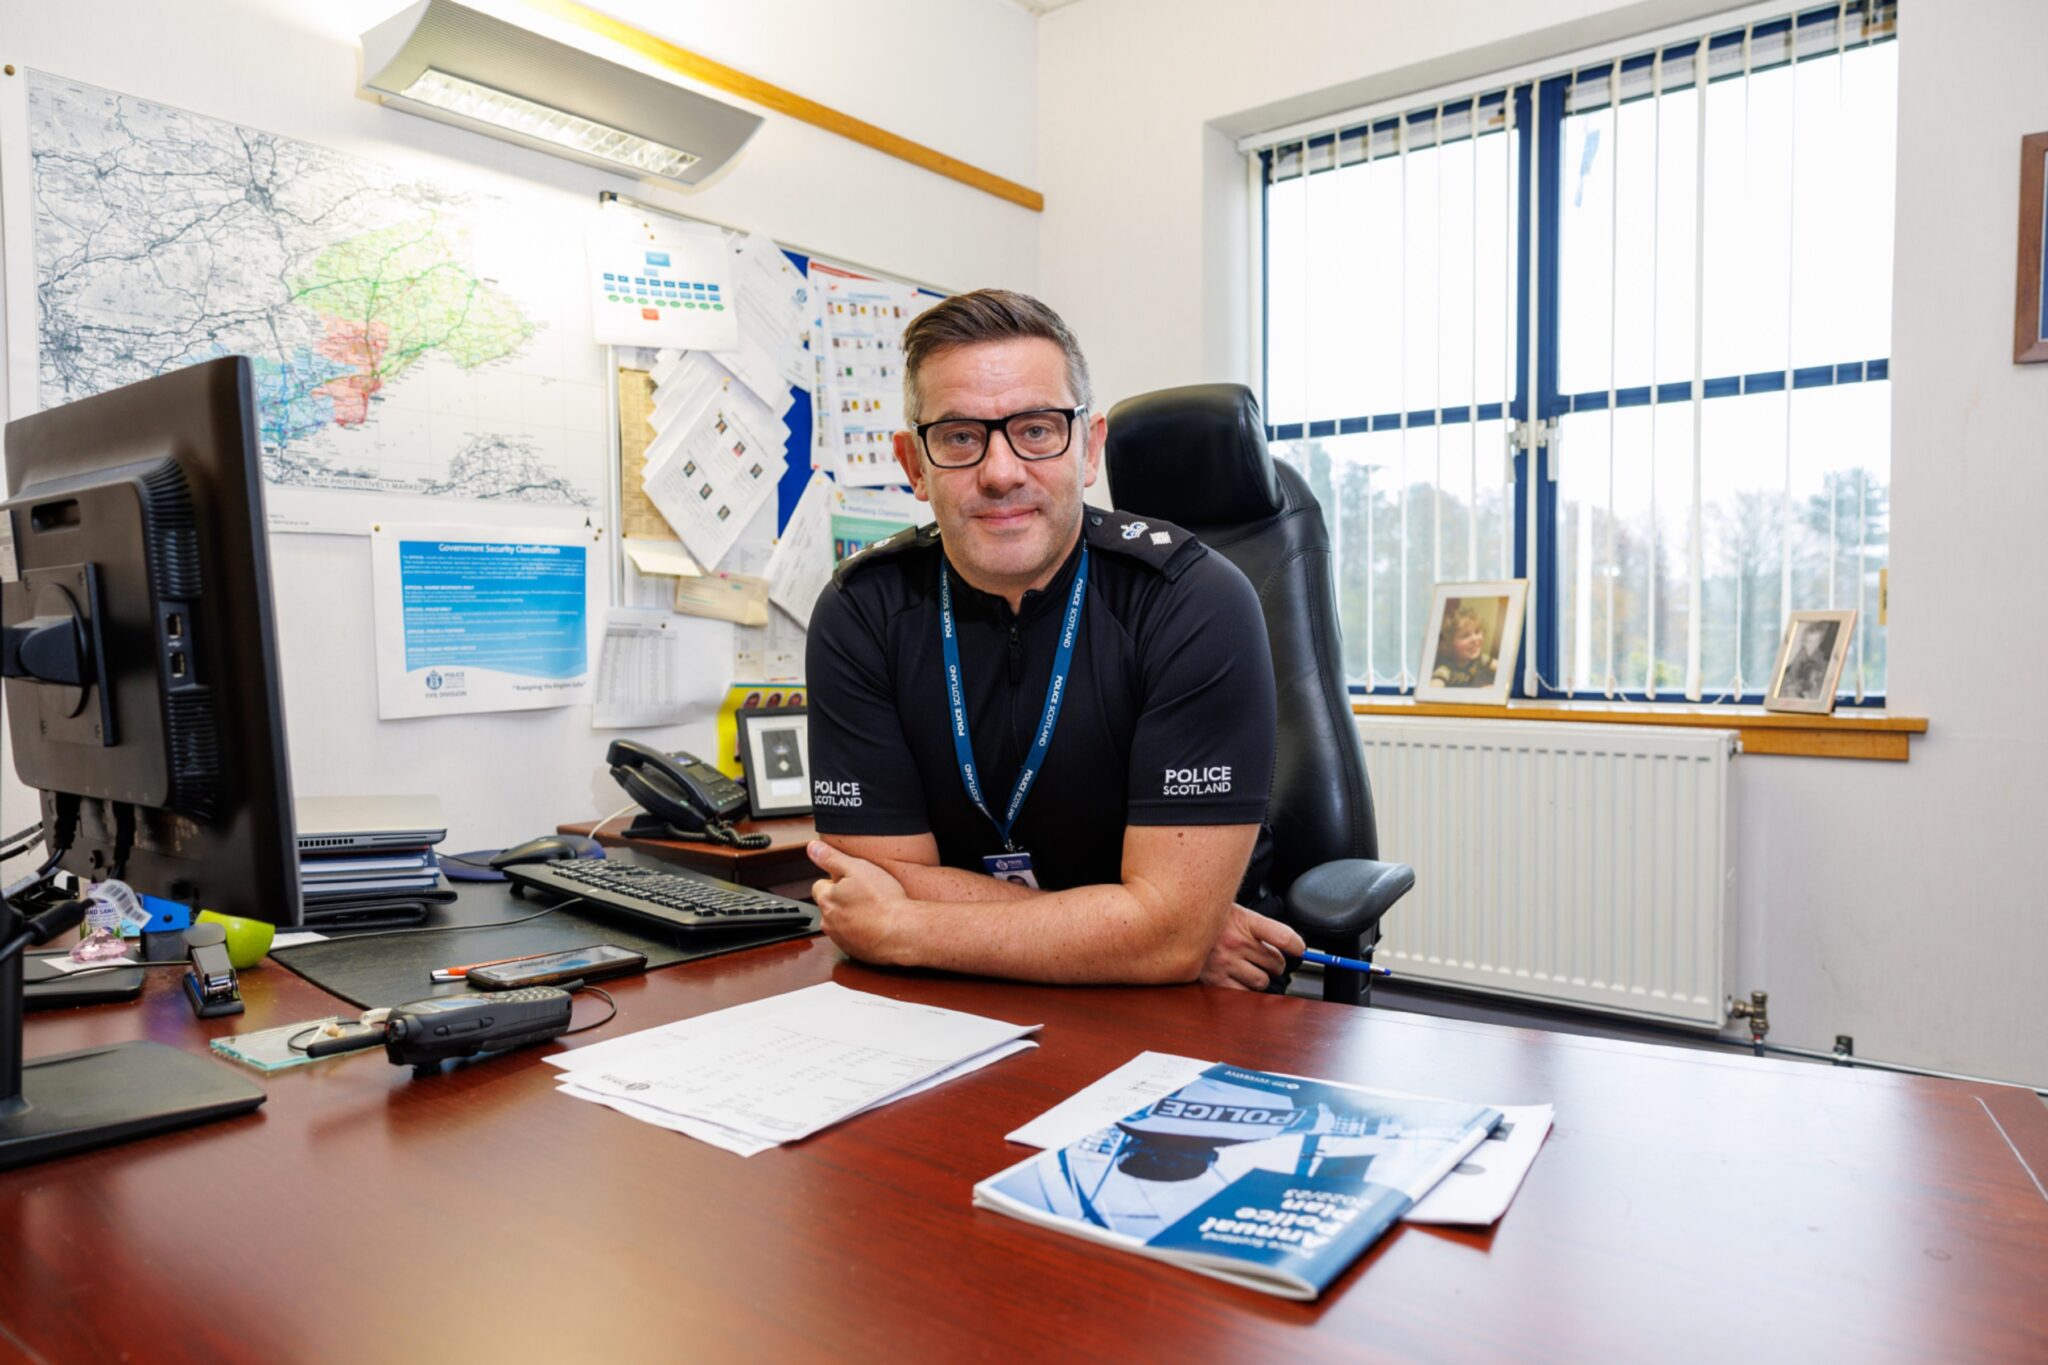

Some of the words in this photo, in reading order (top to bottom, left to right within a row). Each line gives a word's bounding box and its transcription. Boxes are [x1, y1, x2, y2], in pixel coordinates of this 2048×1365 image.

[438, 543, 484, 553] Government
[485, 544, 515, 556] Security
[515, 544, 561, 555] Classification
[1072, 577, 1084, 607] POLICE
[944, 610, 953, 638] POLICE
[1063, 607, 1078, 648] SCOTLAND
[949, 664, 961, 706] SCOTLAND
[1050, 674, 1063, 705] POLICE
[955, 708, 966, 736] POLICE
[1039, 704, 1056, 747] SCOTLAND
[814, 780, 861, 796] POLICE
[964, 763, 981, 802] SCOTLAND
[1018, 768, 1034, 792] POLICE
[1163, 781, 1231, 796] SCOTLAND
[1165, 765, 1232, 784] POLICE
[814, 795, 863, 807] SCOTLAND
[1007, 791, 1023, 820] SCOTLAND
[1158, 1100, 1296, 1125] POLICE
[1234, 1206, 1344, 1236] Police
[1280, 1198, 1360, 1223] Plan
[1198, 1216, 1331, 1250] Annual
